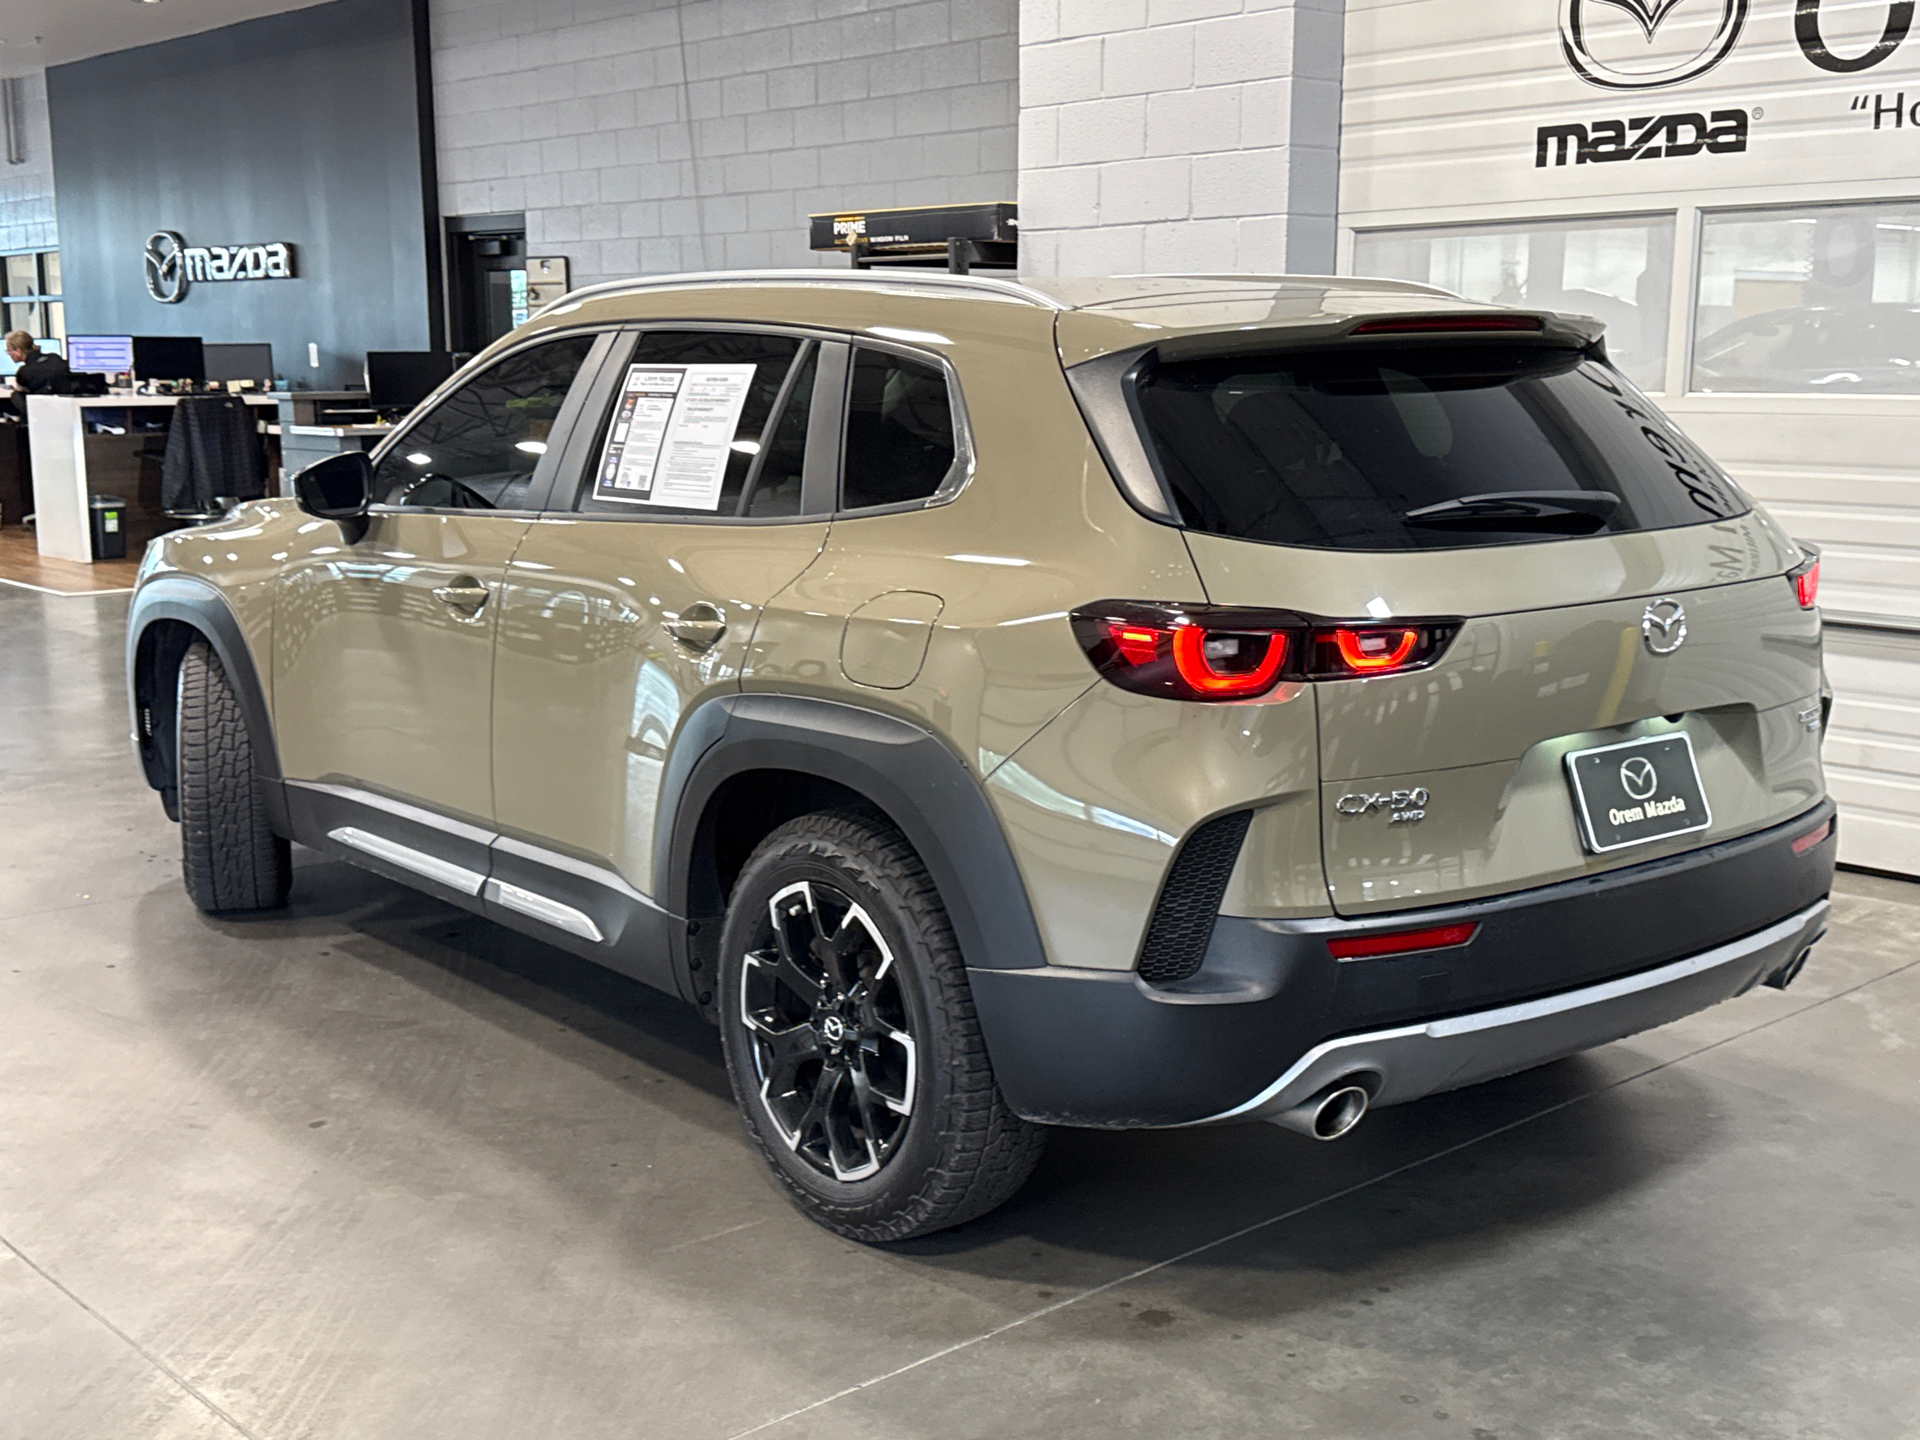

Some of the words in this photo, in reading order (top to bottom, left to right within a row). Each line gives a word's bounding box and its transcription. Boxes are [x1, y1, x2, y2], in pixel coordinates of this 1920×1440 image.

[833, 220, 867, 235] PRIME
[1335, 787, 1430, 813] CX-50
[1608, 808, 1644, 826] Orem
[1643, 795, 1687, 818] Mazda
